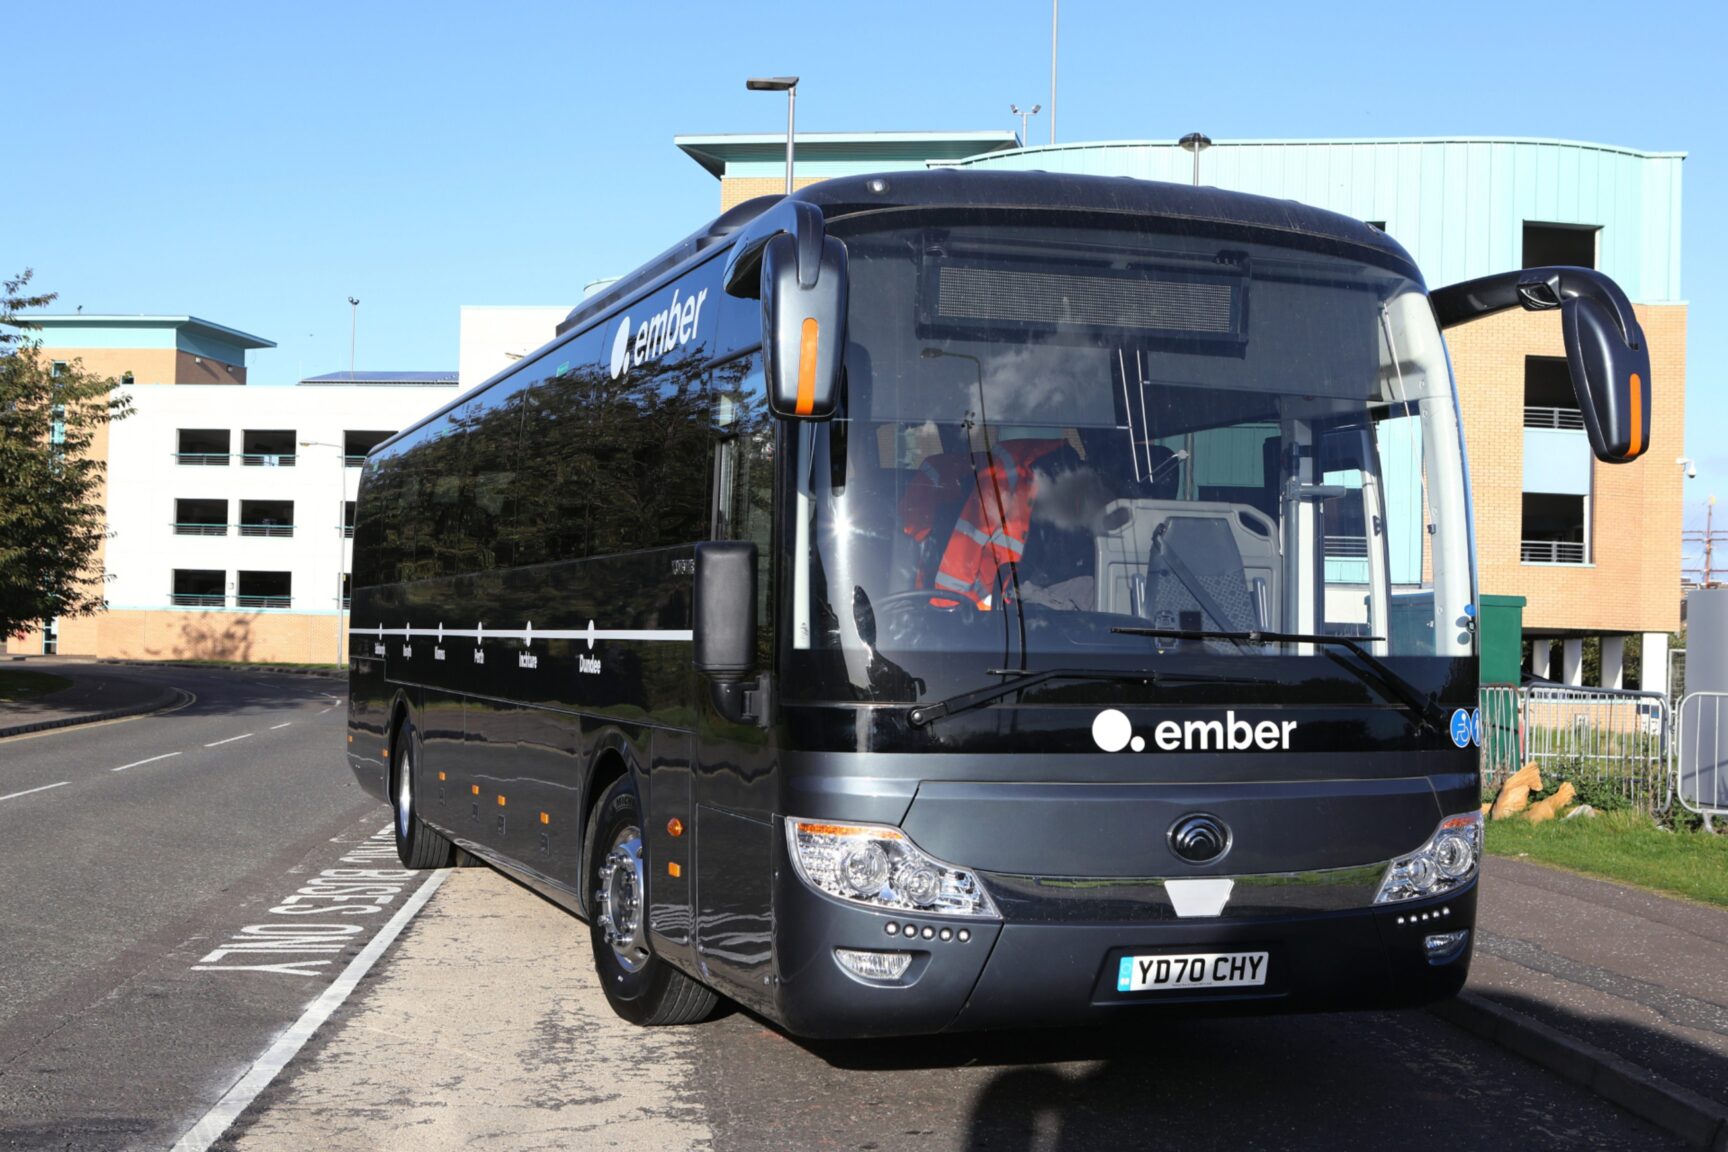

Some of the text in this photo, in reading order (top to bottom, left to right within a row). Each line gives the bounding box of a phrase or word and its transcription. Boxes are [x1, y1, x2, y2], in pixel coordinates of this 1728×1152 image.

[634, 288, 708, 366] ember
[579, 653, 601, 675] Dundee
[1155, 710, 1297, 751] ember
[190, 868, 421, 976] BUSES ONLY
[1139, 955, 1264, 985] YD70 CHY
